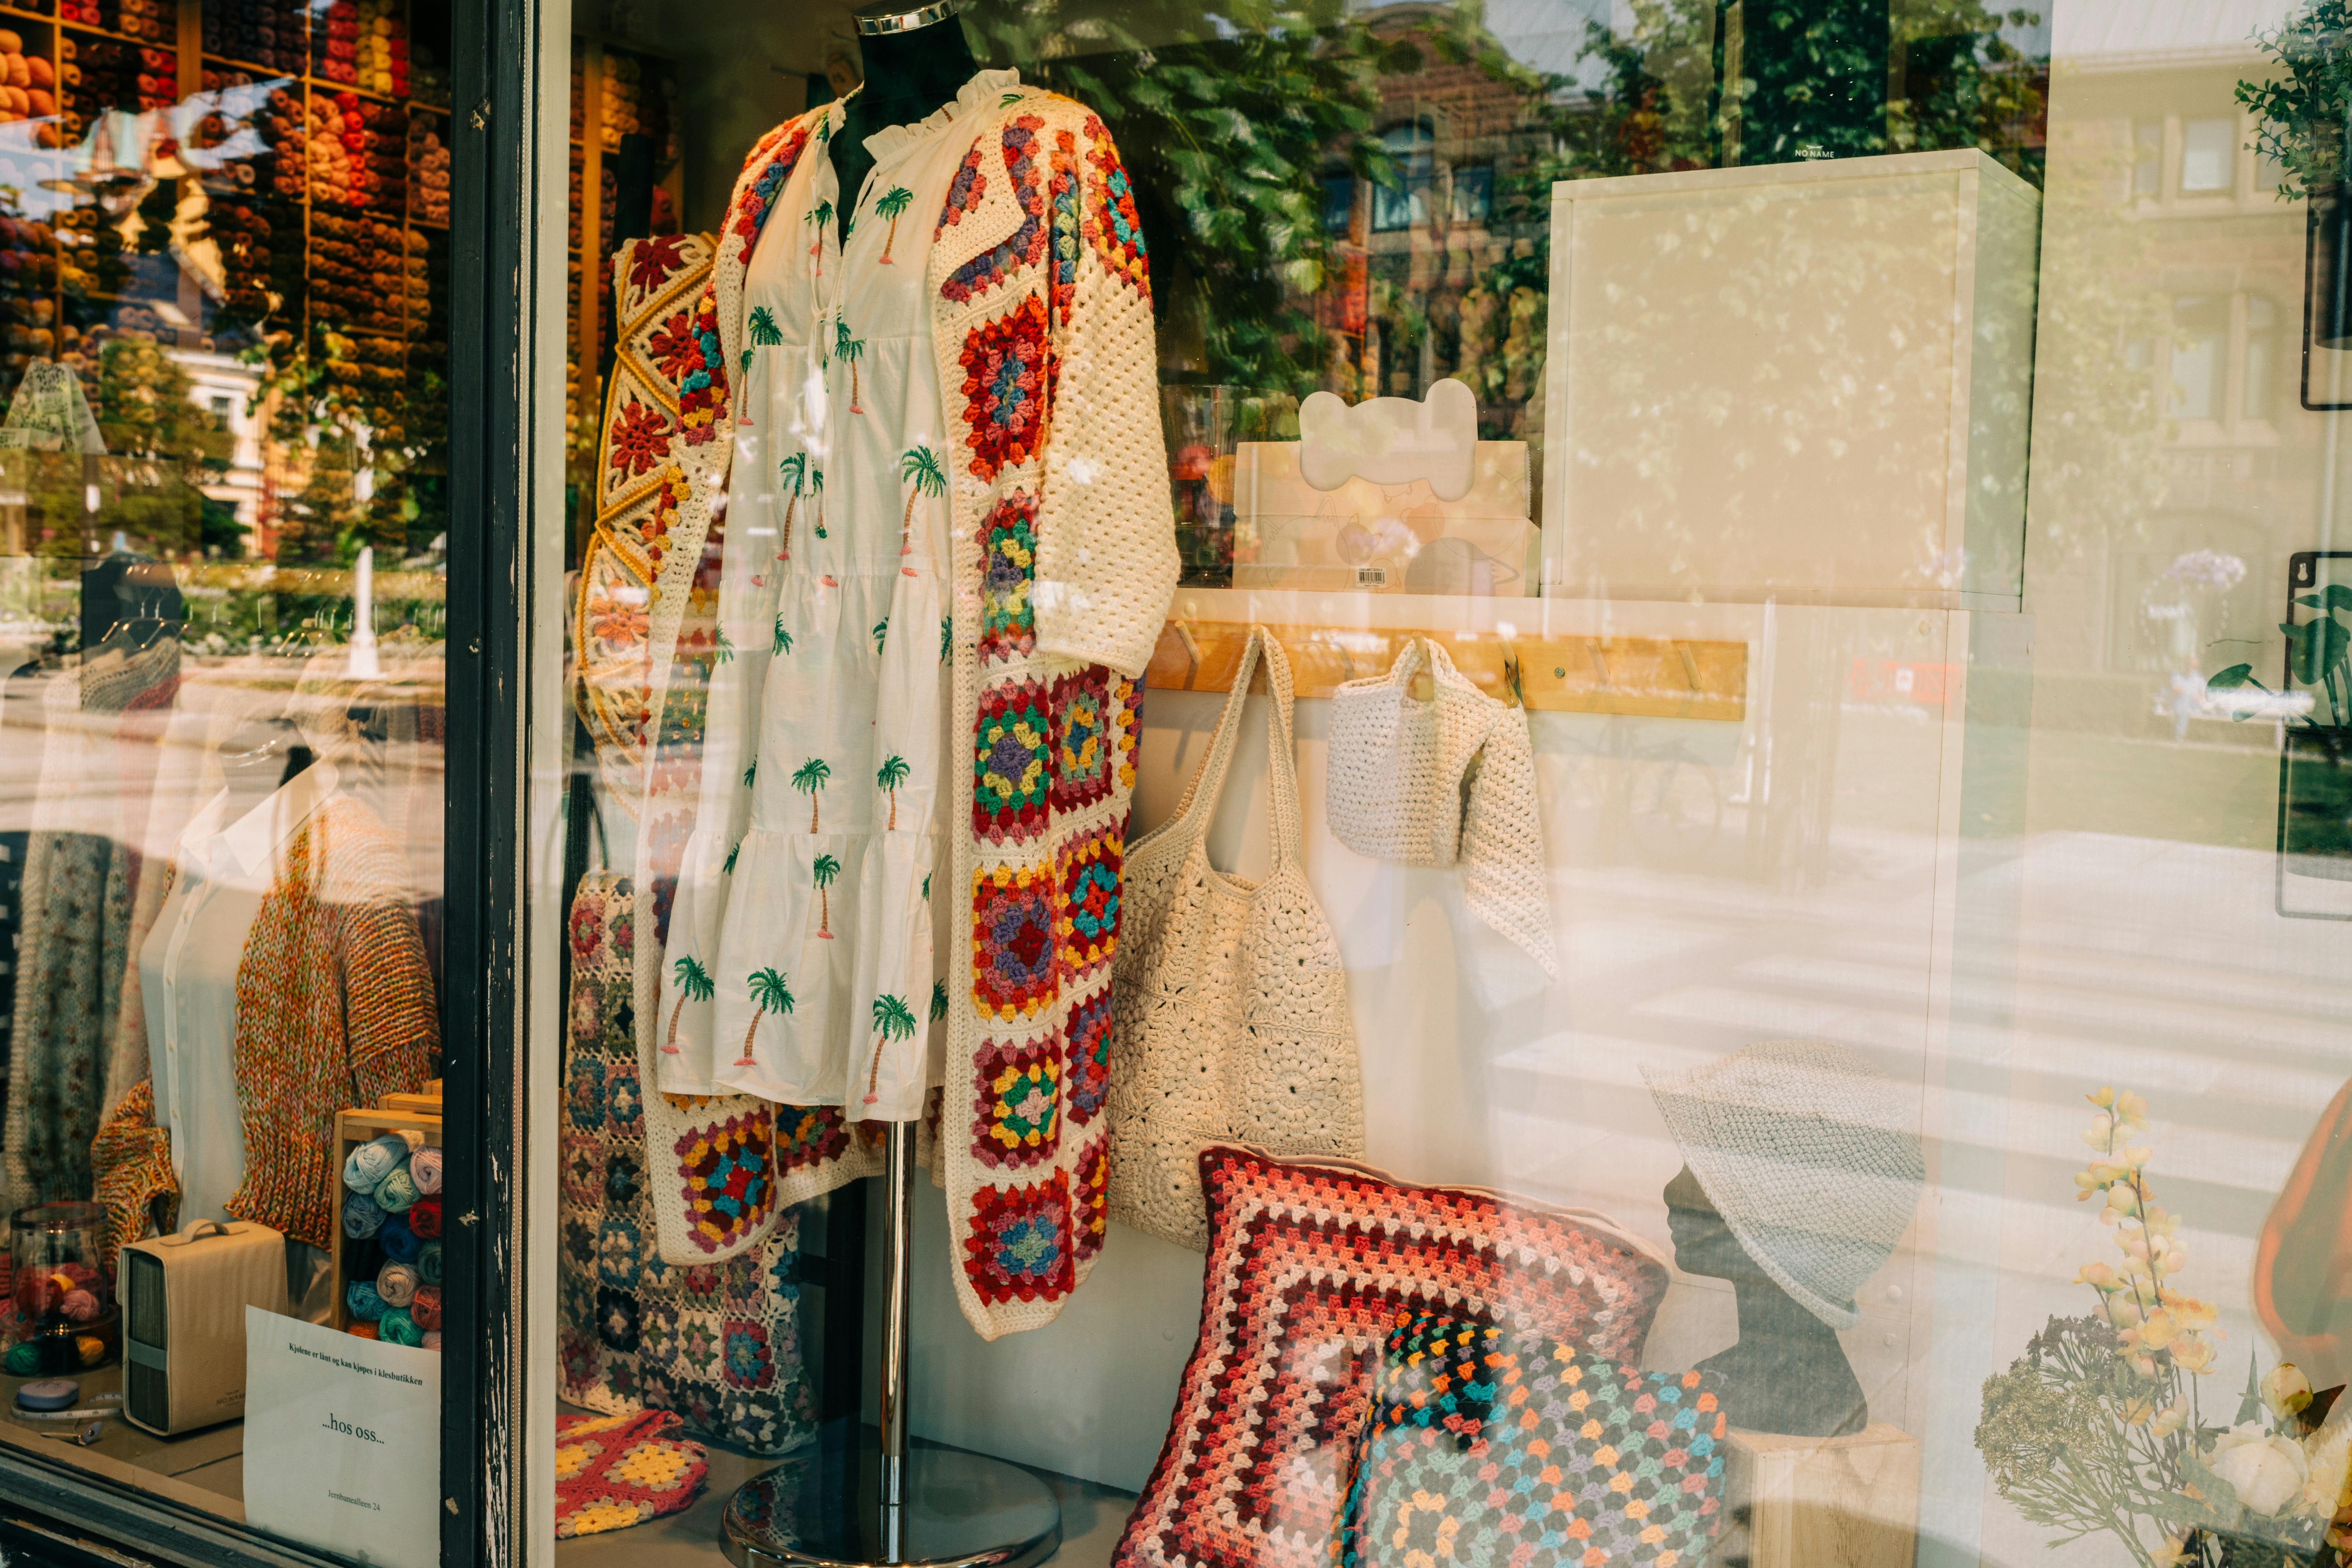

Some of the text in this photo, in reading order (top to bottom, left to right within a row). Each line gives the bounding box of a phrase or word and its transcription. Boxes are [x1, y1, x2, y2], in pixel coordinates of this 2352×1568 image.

[320, 1352, 331, 1362] lånt
[332, 1358, 339, 1366] og
[341, 1358, 352, 1368] kan
[353, 1362, 372, 1375] kjøpes
[378, 1369, 423, 1386] klesbutikken
[328, 1489, 380, 1512] Jernbanealleen 24
